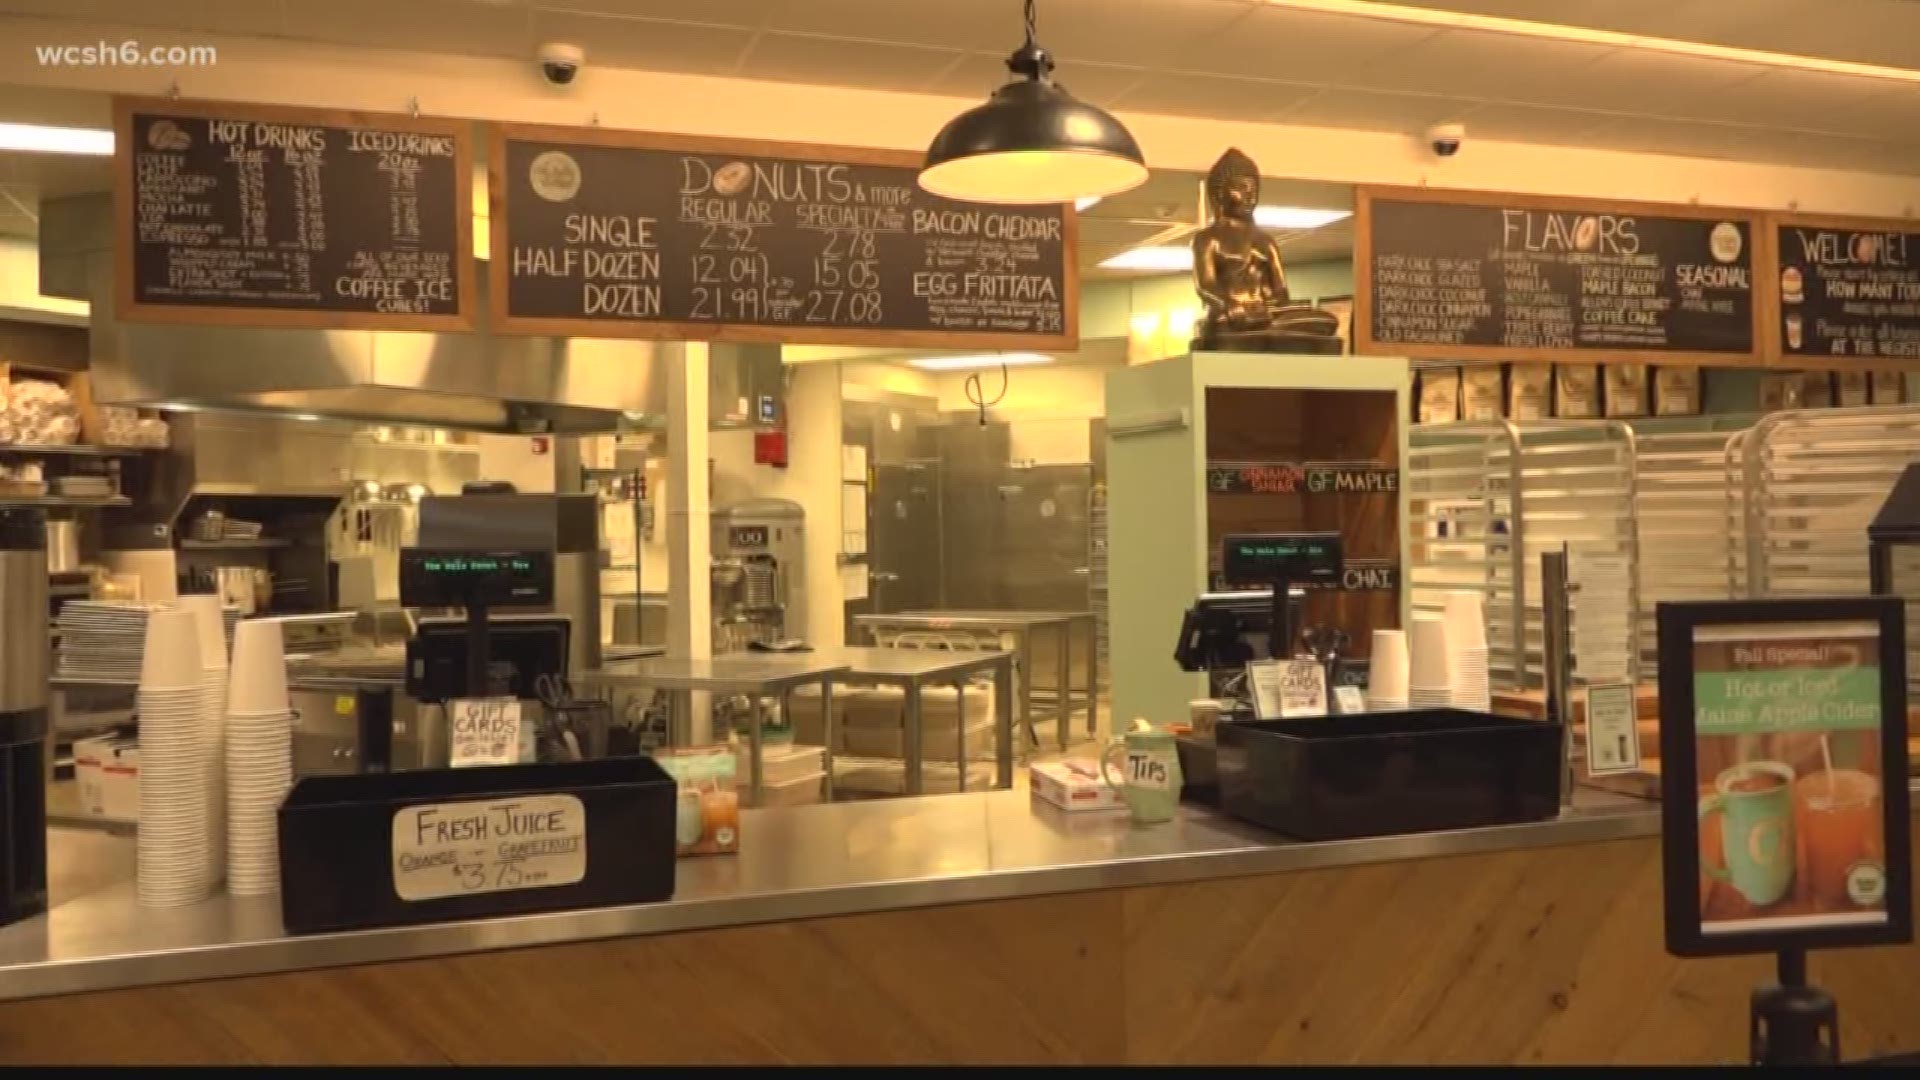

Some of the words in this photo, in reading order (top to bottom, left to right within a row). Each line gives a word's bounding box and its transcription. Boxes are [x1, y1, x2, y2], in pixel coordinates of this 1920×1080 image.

[209, 120, 247, 146] HOT
[254, 123, 326, 150] DRINKS
[348, 131, 396, 151] ICED
[399, 134, 455, 157] DRINKS
[378, 154, 400, 169] 20
[870, 186, 911, 206] more
[171, 204, 212, 216] LATTE
[681, 198, 772, 223] REGULAR
[796, 204, 880, 228] SPECIALTY
[565, 215, 658, 248] SINGLE
[912, 209, 980, 235] BACON
[984, 215, 1061, 241] CHEDDAR
[514, 247, 578, 277] HALF
[584, 251, 660, 280] DOZEN
[913, 272, 958, 297] EGG
[964, 272, 1057, 300] FRITTATA
[1676, 265, 1749, 288] SEASONAL
[336, 277, 404, 299] COFFEE
[416, 278, 452, 301] ICE
[584, 284, 661, 316] DOZEN
[1827, 280, 1855, 298] HOW
[806, 291, 882, 323] 27.08
[1583, 310, 1626, 324] COFFEE
[1308, 469, 1334, 492] GF
[1335, 470, 1396, 492] MAPLE
[1343, 568, 1393, 589] CHAI
[1734, 647, 1762, 663] Fall
[1725, 678, 1765, 698] Hot
[1768, 682, 1793, 697] or
[1797, 676, 1839, 696] Iced
[467, 703, 506, 720] GIFT
[1757, 702, 1819, 726] Apple
[1822, 700, 1879, 721] Cider
[456, 719, 516, 733] CARDS
[416, 808, 488, 846] FRESH
[489, 804, 566, 836] JUICE
[499, 835, 582, 860] GRAPEFRUIT
